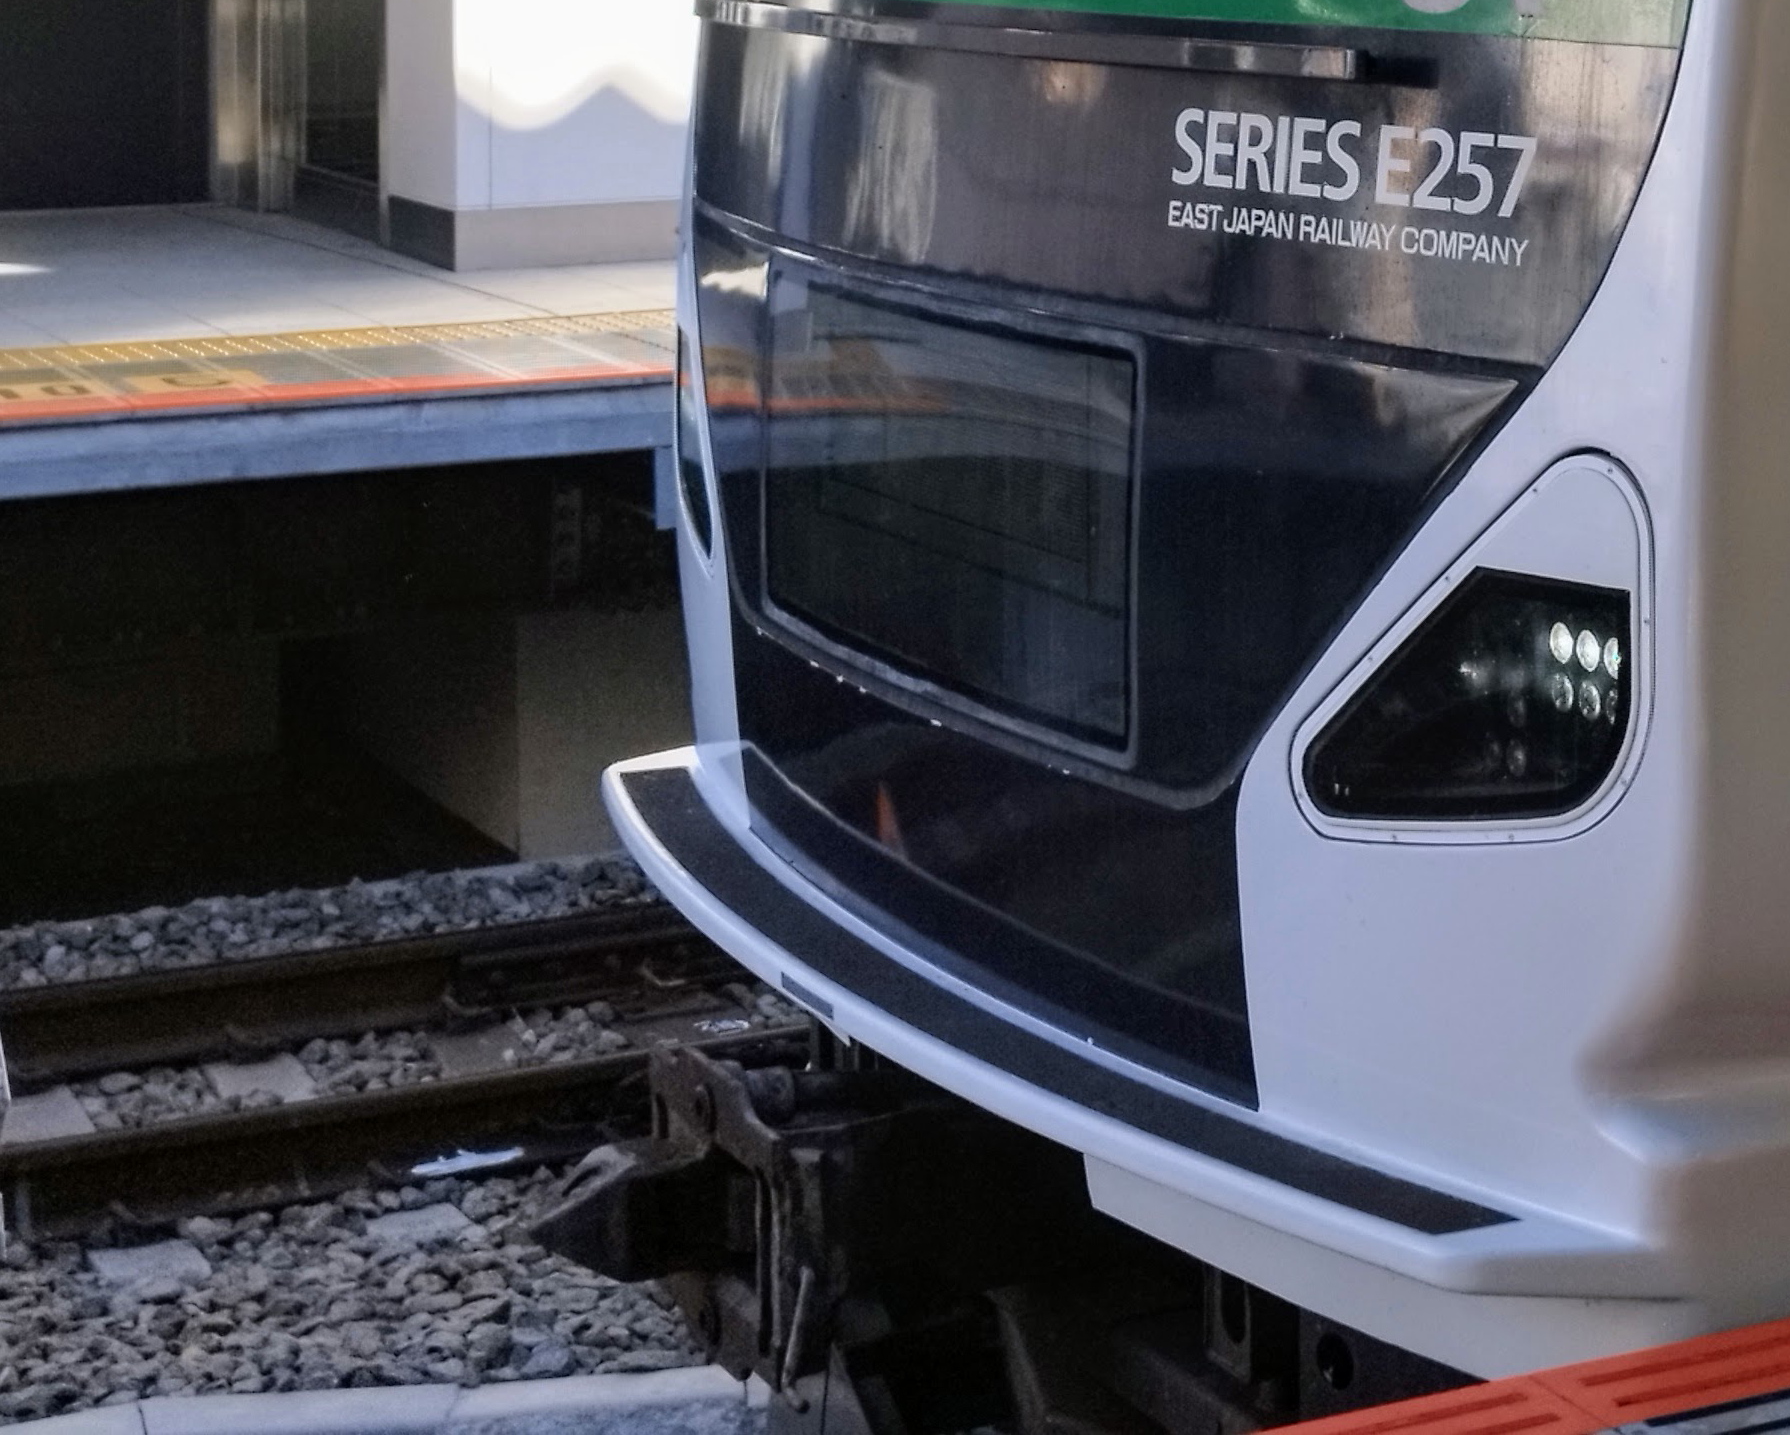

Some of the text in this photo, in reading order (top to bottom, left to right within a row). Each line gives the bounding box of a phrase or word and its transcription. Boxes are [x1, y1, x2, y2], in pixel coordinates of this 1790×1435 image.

[1171, 107, 1538, 219] SERIES E257
[1167, 200, 1530, 267] EAST JAPAN RAILWAY COMPANY
